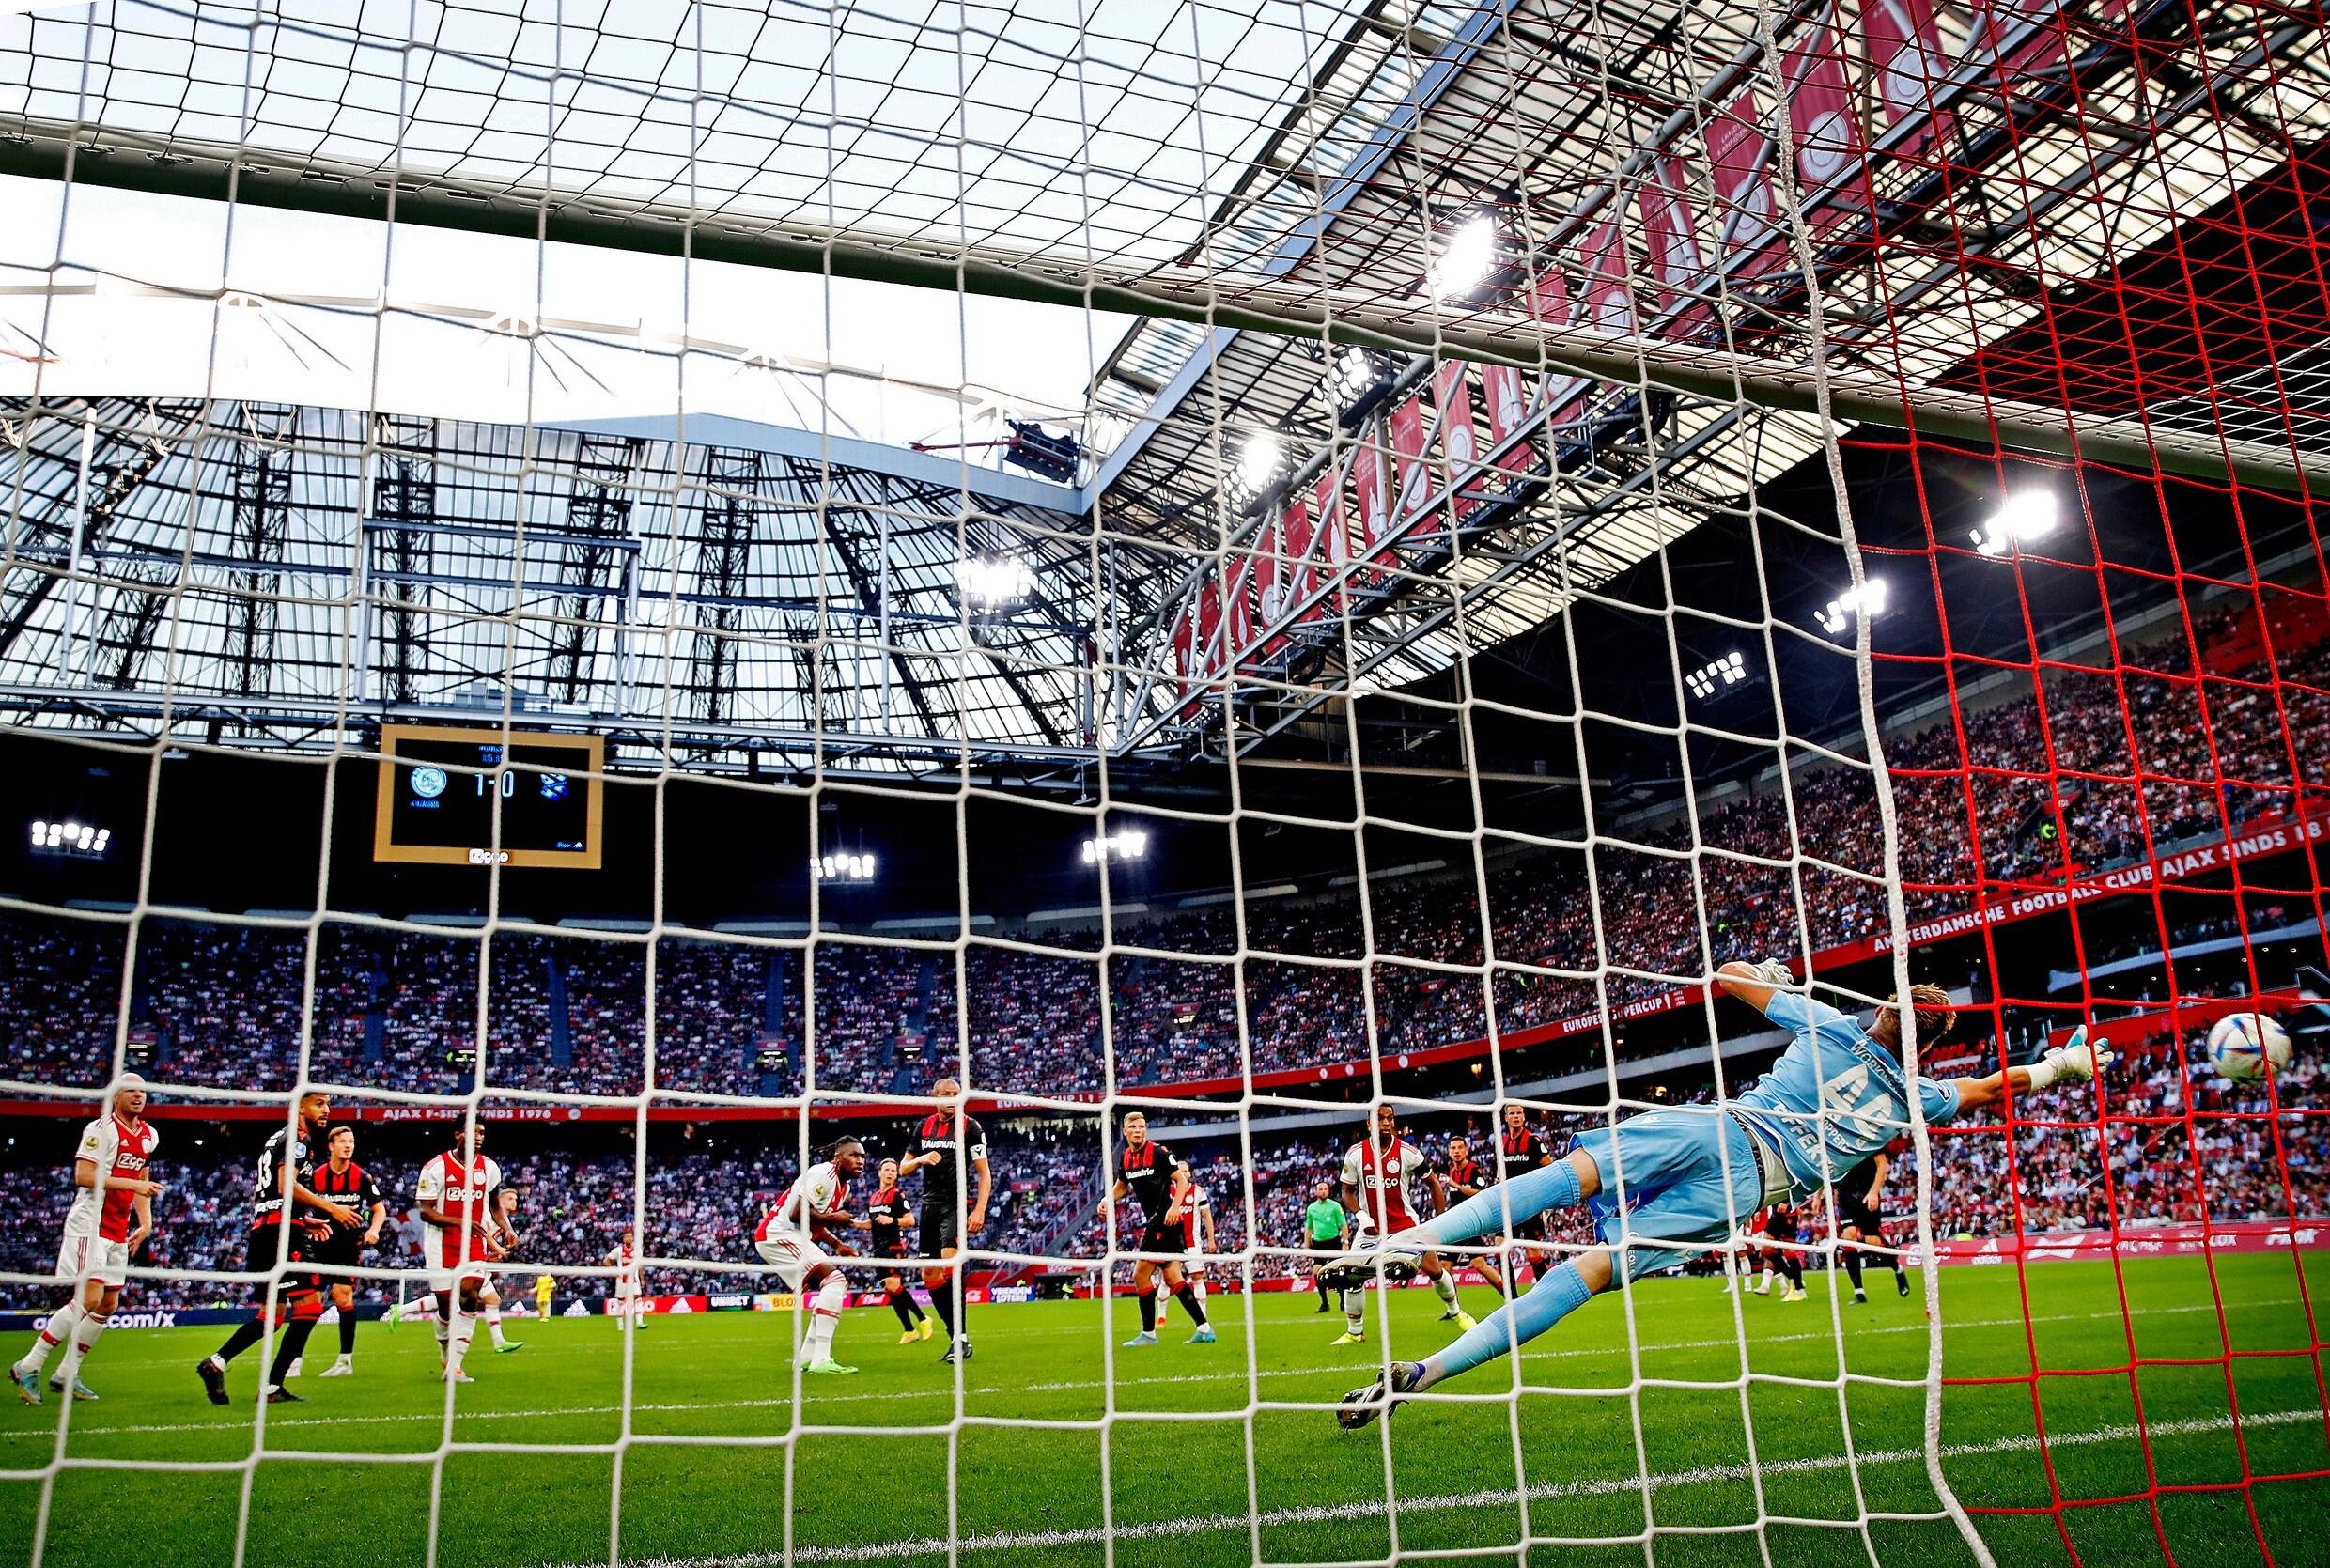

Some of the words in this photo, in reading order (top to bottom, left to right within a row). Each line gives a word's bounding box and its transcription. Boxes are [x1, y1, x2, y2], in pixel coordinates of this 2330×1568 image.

[1873, 905, 2006, 953] AMTERDAMSCHE
[2105, 865, 2153, 889] CLUB
[2161, 848, 2217, 877] AJAX
[2220, 831, 2287, 861] SINDS
[1562, 1009, 1608, 1033] EUROPES
[383, 1108, 422, 1120] AJAX
[425, 1109, 467, 1119] F-SID
[475, 1109, 514, 1119] INDS
[520, 1109, 551, 1119] 1976
[1821, 1116, 1852, 1153] OPPERT
[710, 1296, 750, 1307] UNIBET
[772, 1297, 796, 1308] BLO
